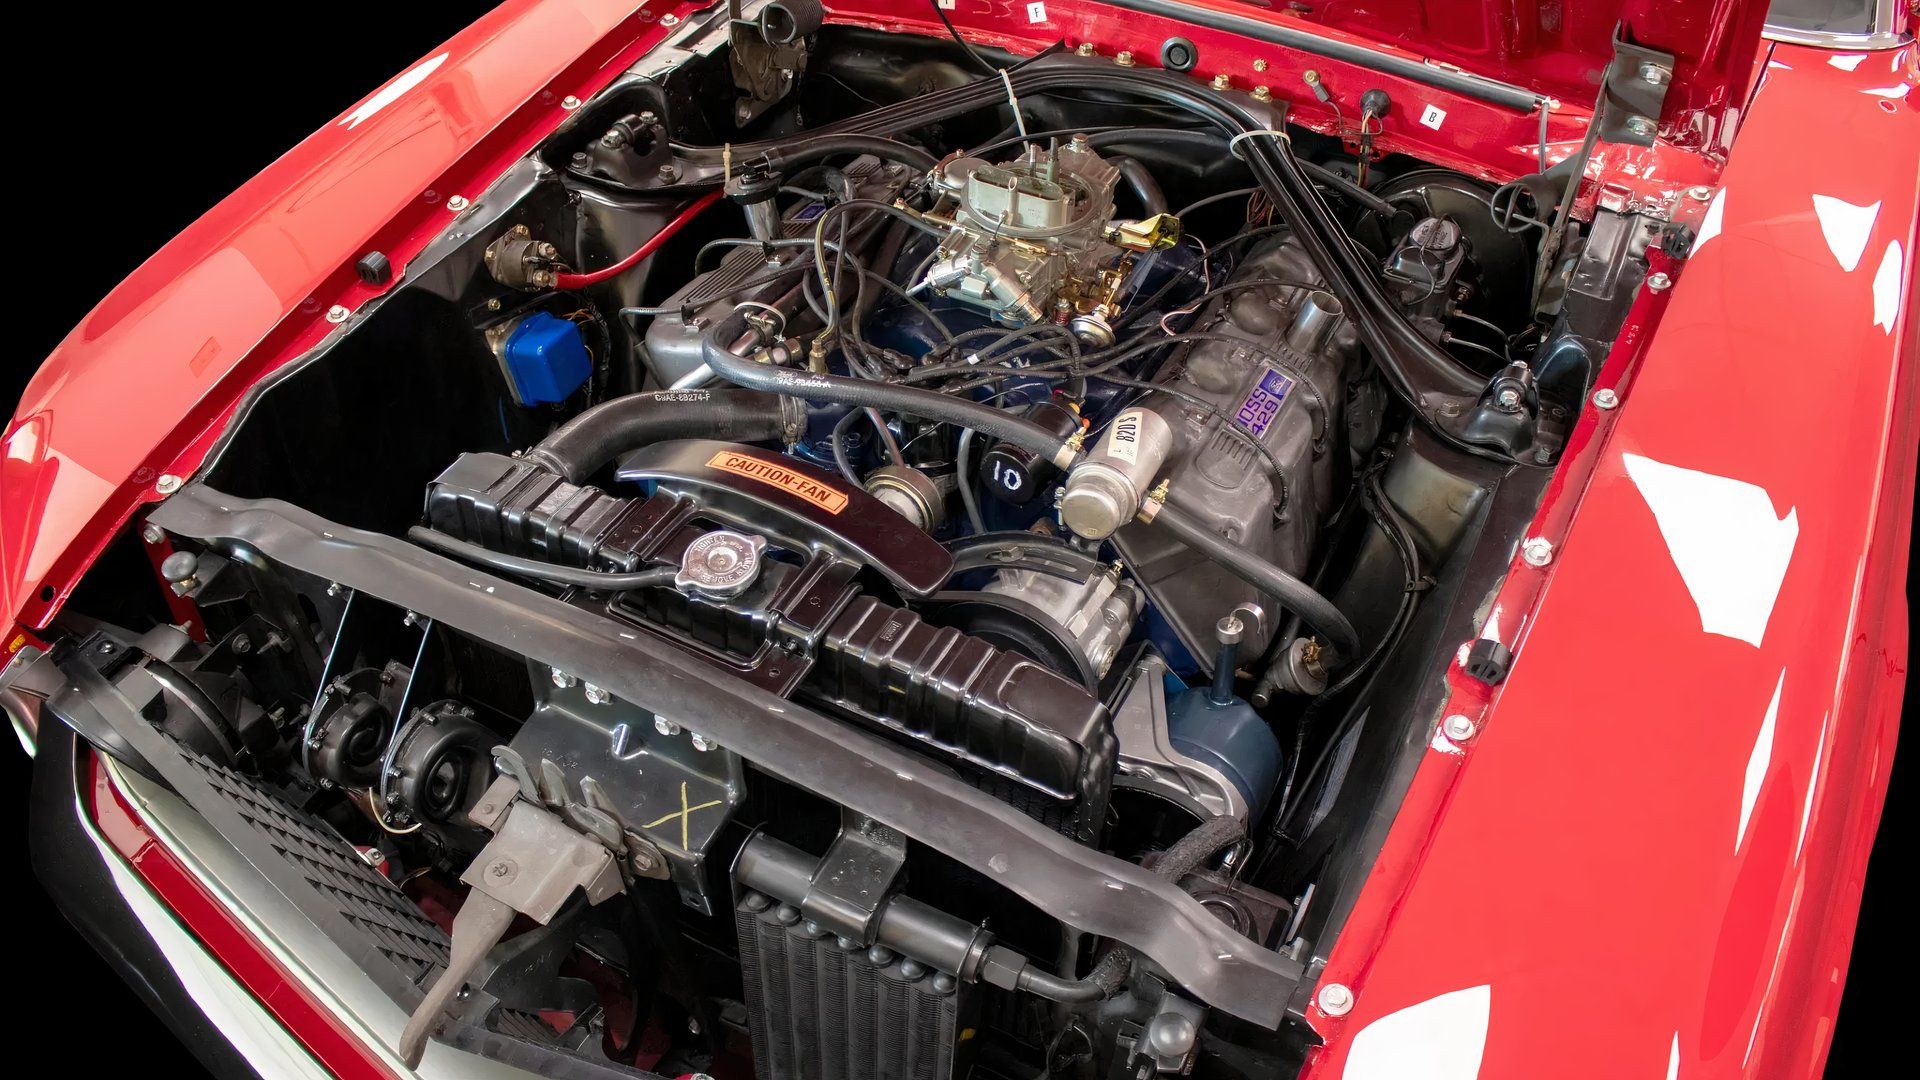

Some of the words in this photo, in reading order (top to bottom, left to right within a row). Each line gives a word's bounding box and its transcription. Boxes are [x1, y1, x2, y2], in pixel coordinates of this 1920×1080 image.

[1033, 7, 1040, 18] F
[1236, 388, 1268, 428] OSS
[1251, 400, 1279, 436] 429
[724, 457, 832, 503] CAUTION-FAN
[993, 460, 1022, 490] 10
